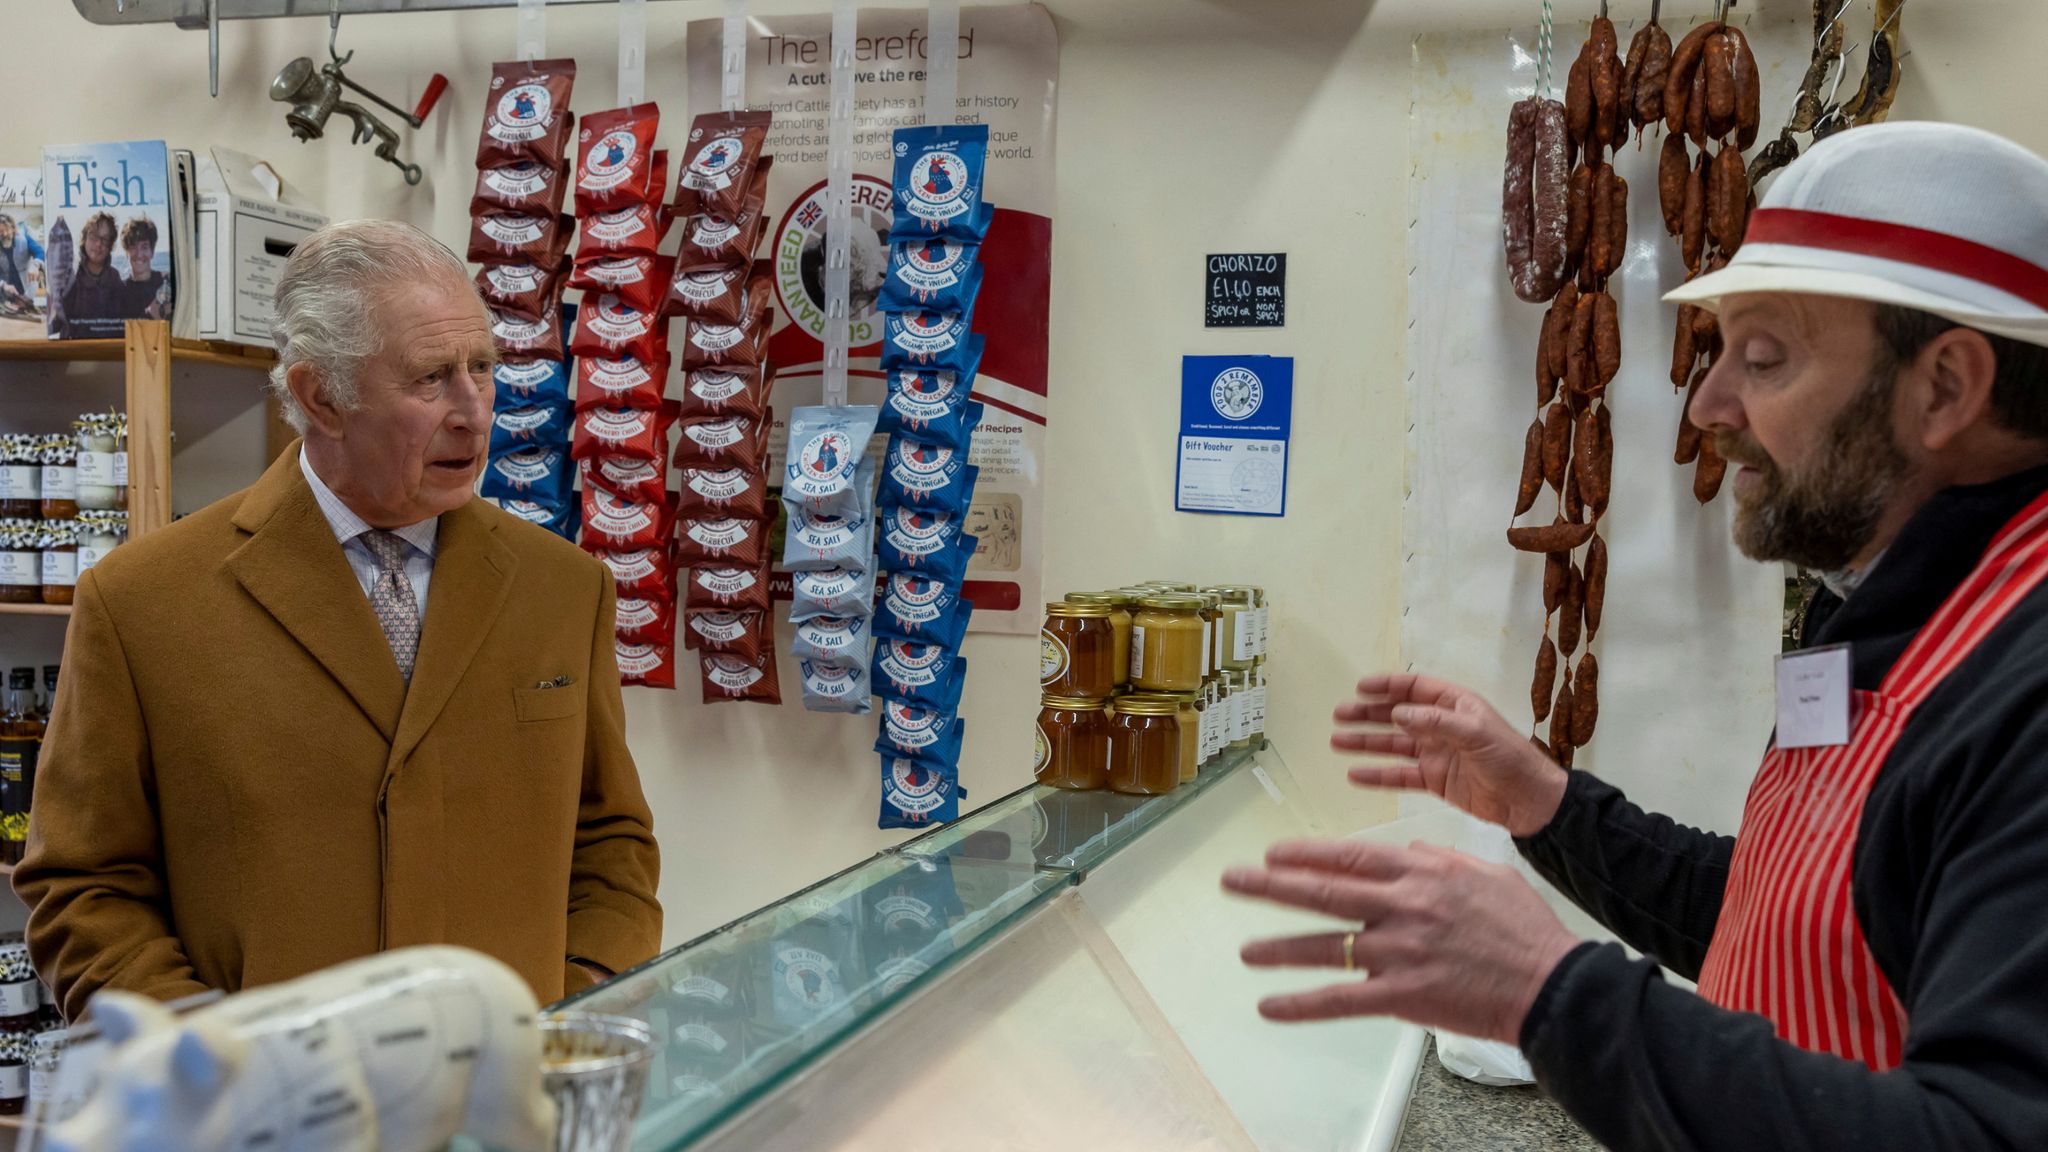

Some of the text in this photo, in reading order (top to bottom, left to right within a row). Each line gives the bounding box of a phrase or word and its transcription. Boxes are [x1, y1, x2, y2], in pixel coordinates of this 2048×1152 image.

[760, 34, 818, 65] The
[788, 73, 798, 86] A
[802, 72, 826, 86] cut
[879, 69, 905, 82] the
[795, 101, 830, 112] Cattle
[883, 97, 905, 109] has
[908, 99, 917, 108] a
[974, 95, 1019, 109] history
[763, 135, 810, 147] erefords
[994, 146, 1035, 159] world.
[917, 158, 929, 170] THE
[57, 159, 149, 208] Fish
[913, 174, 965, 202] CHICKEN CRACKLING
[938, 203, 964, 217] VINEGAR
[492, 229, 529, 241] BARBECUE
[1209, 255, 1277, 274] CHORIZO
[901, 269, 953, 287] BALSAMIC VINEGAR
[683, 285, 716, 298] BARBECUE
[1256, 286, 1281, 297] EACH
[1211, 302, 1239, 319] SPICY
[1256, 303, 1276, 312] NON
[1256, 311, 1279, 321] SPICY
[501, 327, 537, 337] BARBECUE
[700, 339, 732, 350] BARBECUE
[898, 335, 951, 351] BALSAMIC VINEGAR
[593, 373, 646, 387] HABANERO CHILLI
[701, 388, 732, 398] BARBECUE
[1229, 371, 1259, 410] REMEMBER
[894, 397, 945, 417] BALSAMIC VINEGAR
[589, 422, 640, 437] HABANERO CHILLI
[985, 424, 1023, 434] Recipes
[695, 432, 730, 446] BARBECUE
[808, 435, 821, 448] THE
[1185, 440, 1202, 450] Gift
[1203, 441, 1234, 452] Voucher
[895, 471, 946, 488] BALSAMIC VINEGAR
[700, 486, 736, 498] BARBECUE
[801, 482, 837, 494] SEA SALT
[595, 518, 647, 533] HABANERO CHILLI
[700, 534, 735, 546] BARBECUE
[807, 534, 841, 546] SEA SALT
[891, 533, 941, 552] BALSAMIC VINEGAR
[633, 564, 651, 577] CHILLI
[708, 580, 743, 592] BARBECUE
[810, 583, 845, 596] SEA SALT
[911, 583, 941, 602] CRACKLIN
[888, 599, 936, 619] BALSAMIC VINEGAR
[635, 613, 654, 624] CHILLI
[700, 627, 734, 639] BARBECUE
[809, 632, 843, 647] SEA SALT
[640, 658, 658, 671] CHILLI
[884, 661, 931, 682] BALSAMIC VINEGAR
[719, 675, 752, 687] BARBECUE
[816, 682, 846, 695] SEA SALT
[911, 733, 933, 745] VINEGAR
[892, 794, 939, 811] BALSAMIC VINEGAR
